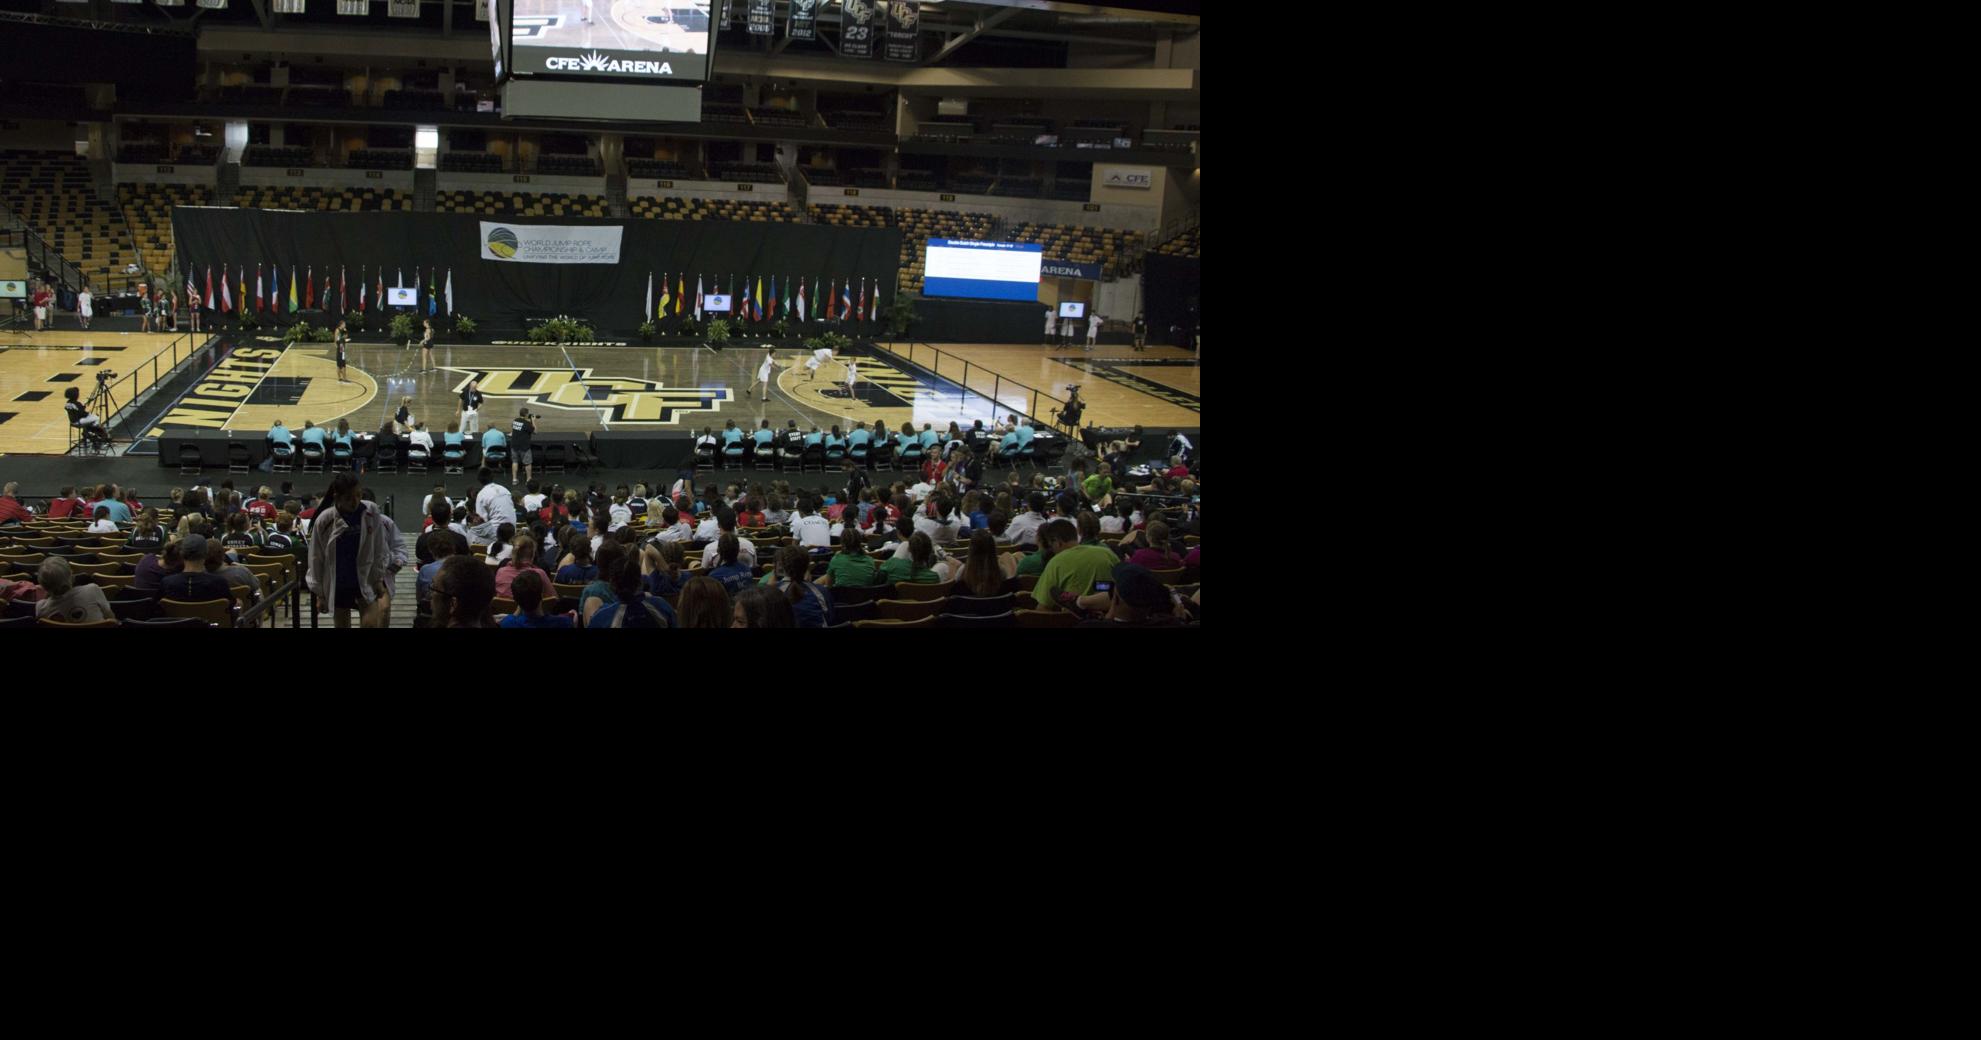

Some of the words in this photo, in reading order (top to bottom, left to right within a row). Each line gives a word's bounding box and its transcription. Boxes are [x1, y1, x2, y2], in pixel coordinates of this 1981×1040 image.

[845, 26, 869, 40] 23
[545, 57, 580, 71] CFE
[606, 60, 673, 75] ARENA
[1126, 174, 1148, 183] CFE
[1040, 265, 1083, 276] ARENA
[434, 367, 734, 424] UCF
